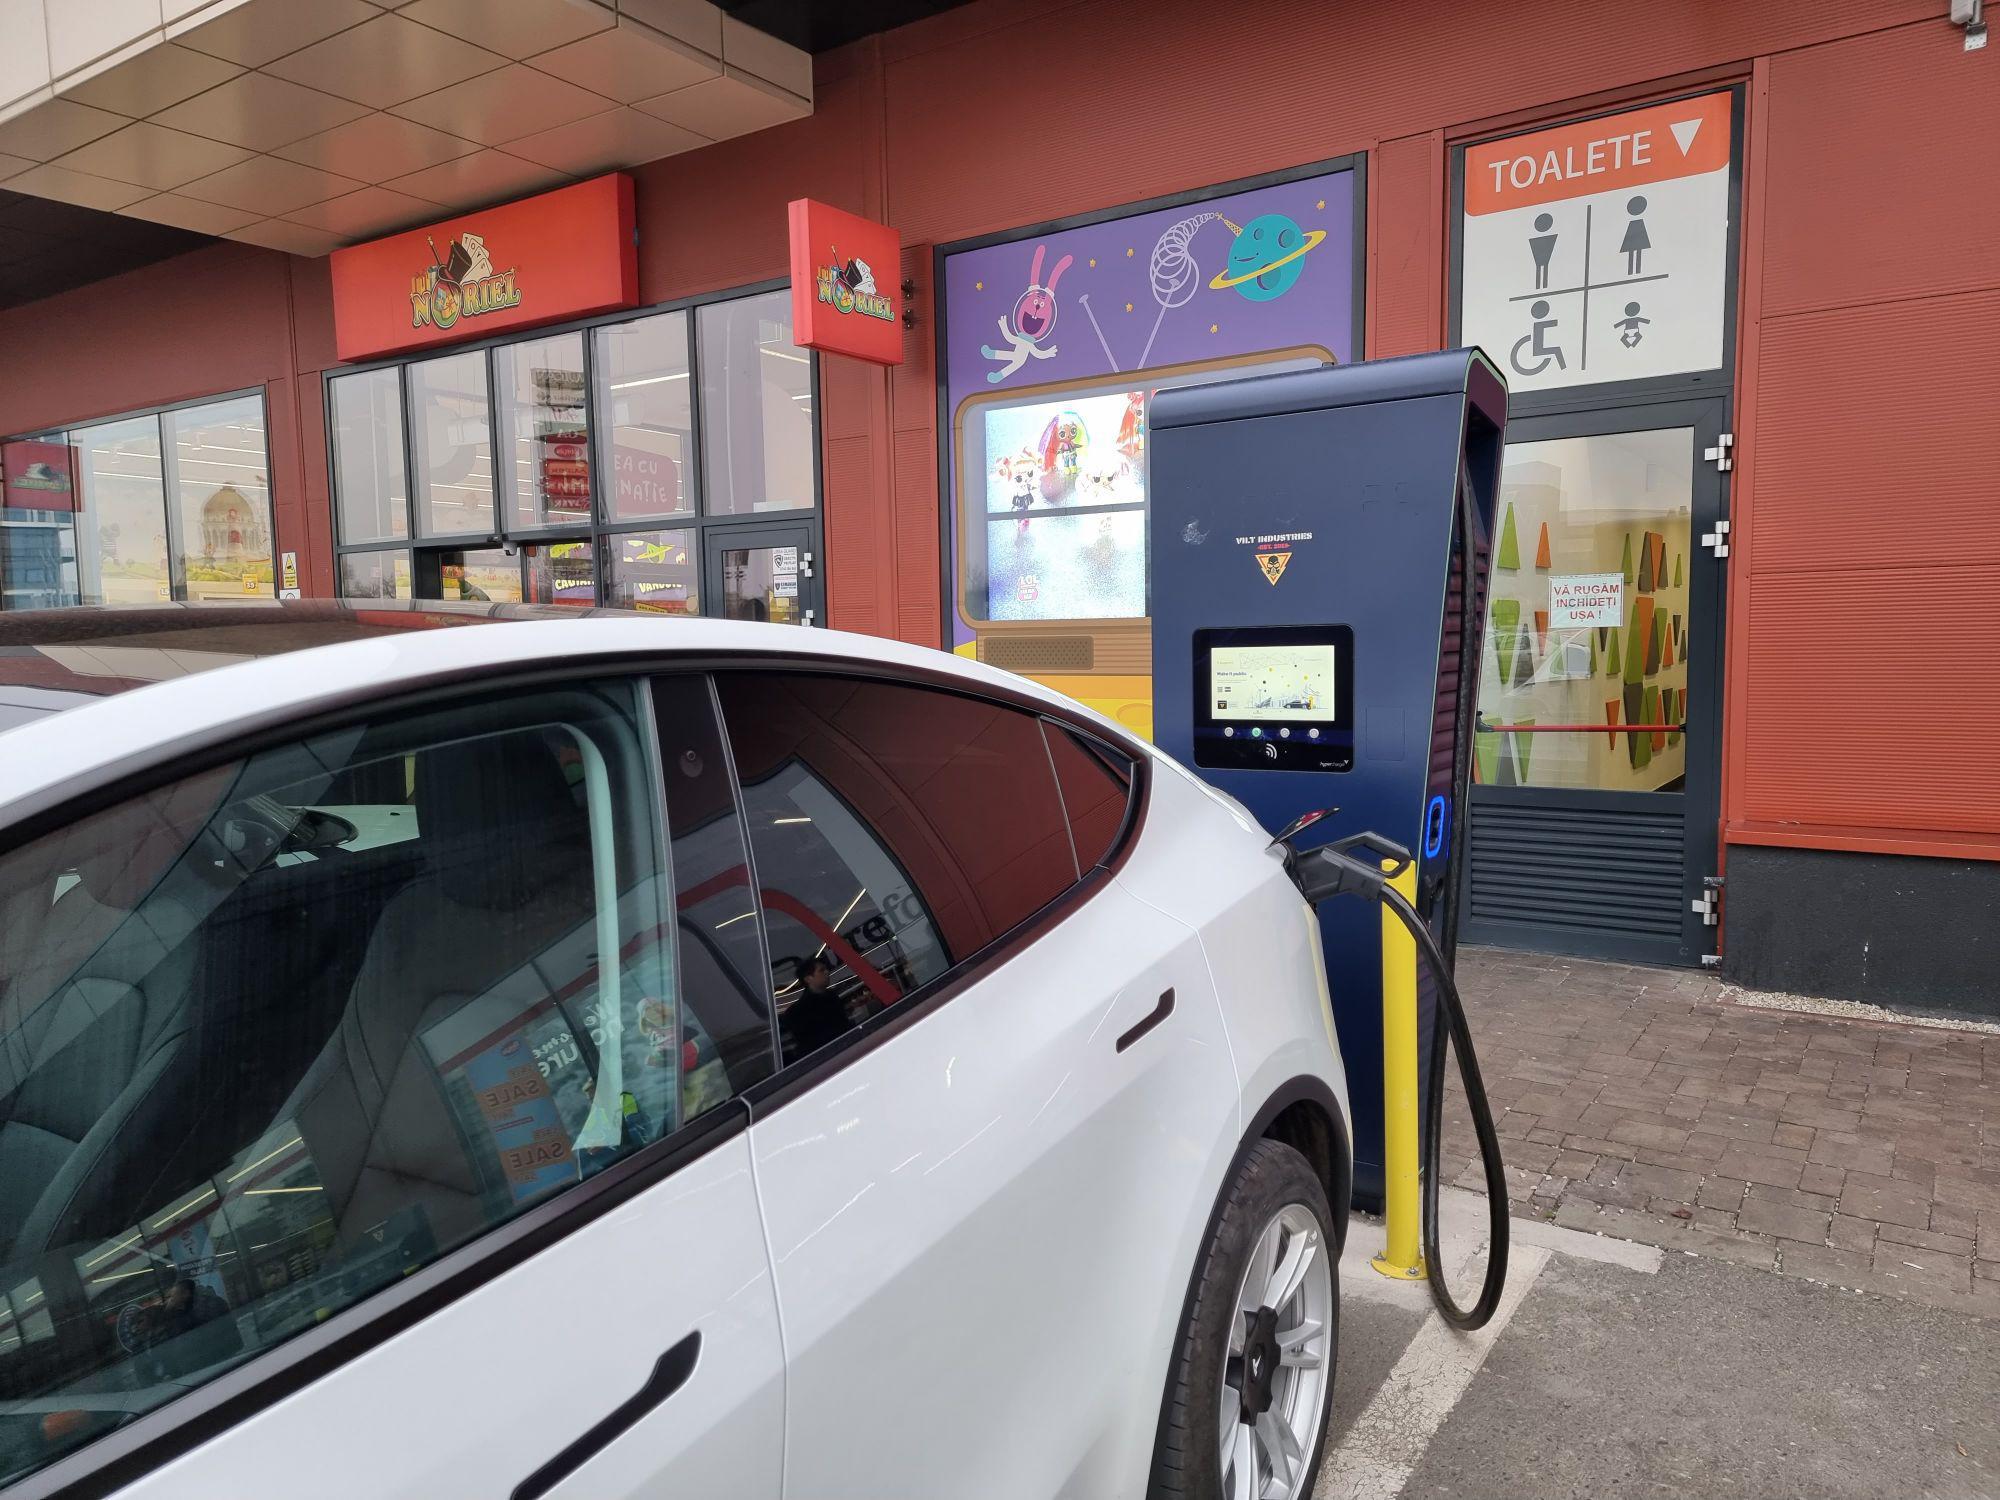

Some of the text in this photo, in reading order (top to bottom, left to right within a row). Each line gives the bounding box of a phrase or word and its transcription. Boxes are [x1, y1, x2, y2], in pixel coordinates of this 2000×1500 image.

[1488, 130, 1652, 193] TOALETE
[410, 270, 522, 328] NORIEL
[816, 277, 895, 322] NORIEL
[1235, 531, 1313, 545] VILT INDUSTRIES
[1554, 582, 1620, 596] VĂ RUGĂM
[1570, 610, 1595, 622] UȘA
